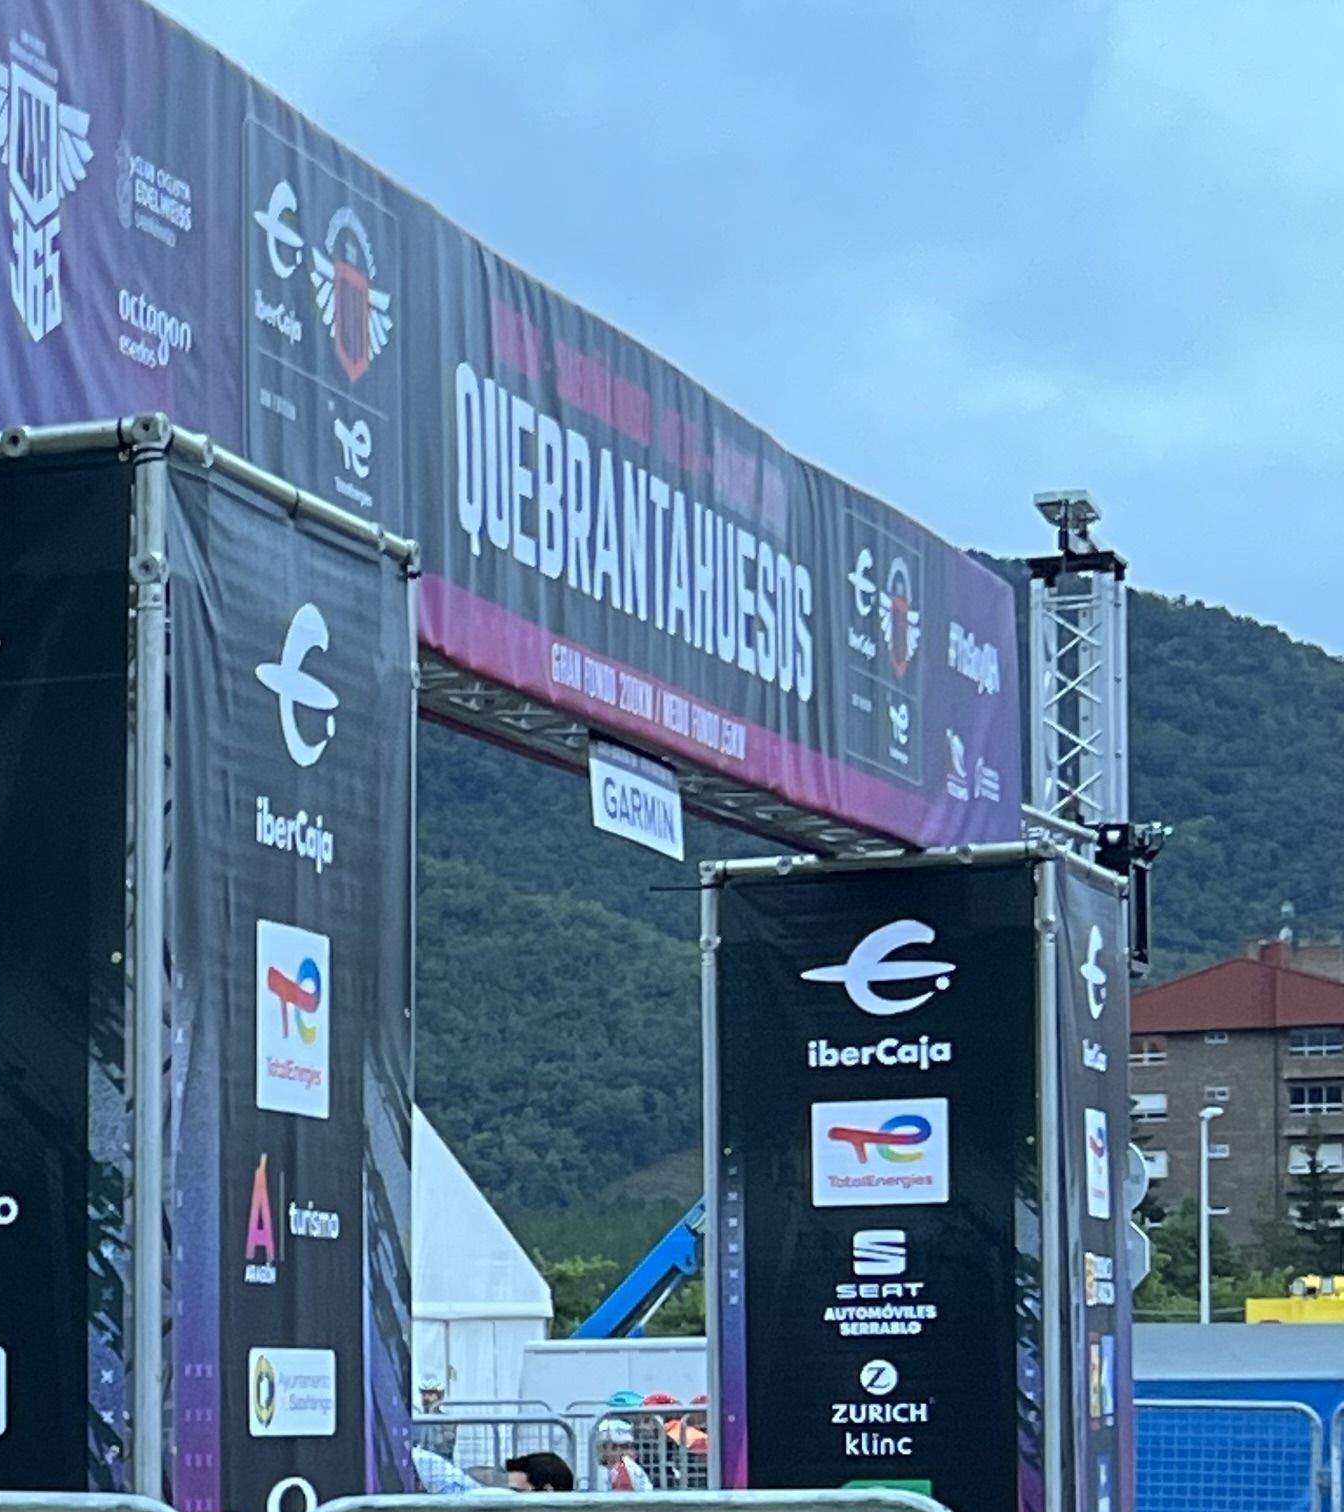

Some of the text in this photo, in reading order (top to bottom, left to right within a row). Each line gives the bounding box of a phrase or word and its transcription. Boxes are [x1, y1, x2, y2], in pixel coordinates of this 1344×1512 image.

[118, 288, 192, 366] octagon
[455, 361, 812, 702] QUEBRANTAHUESOS
[603, 776, 676, 845] GARMIN
[256, 796, 334, 875] iberCaja
[808, 1035, 951, 1070] iberCaja
[828, 1173, 933, 1189] TotalEnergies
[836, 1282, 924, 1299] SEAT
[824, 1303, 937, 1321] AUTOMÓVILES
[839, 1321, 922, 1336] SERRABLO
[831, 1403, 928, 1423] ZURICH
